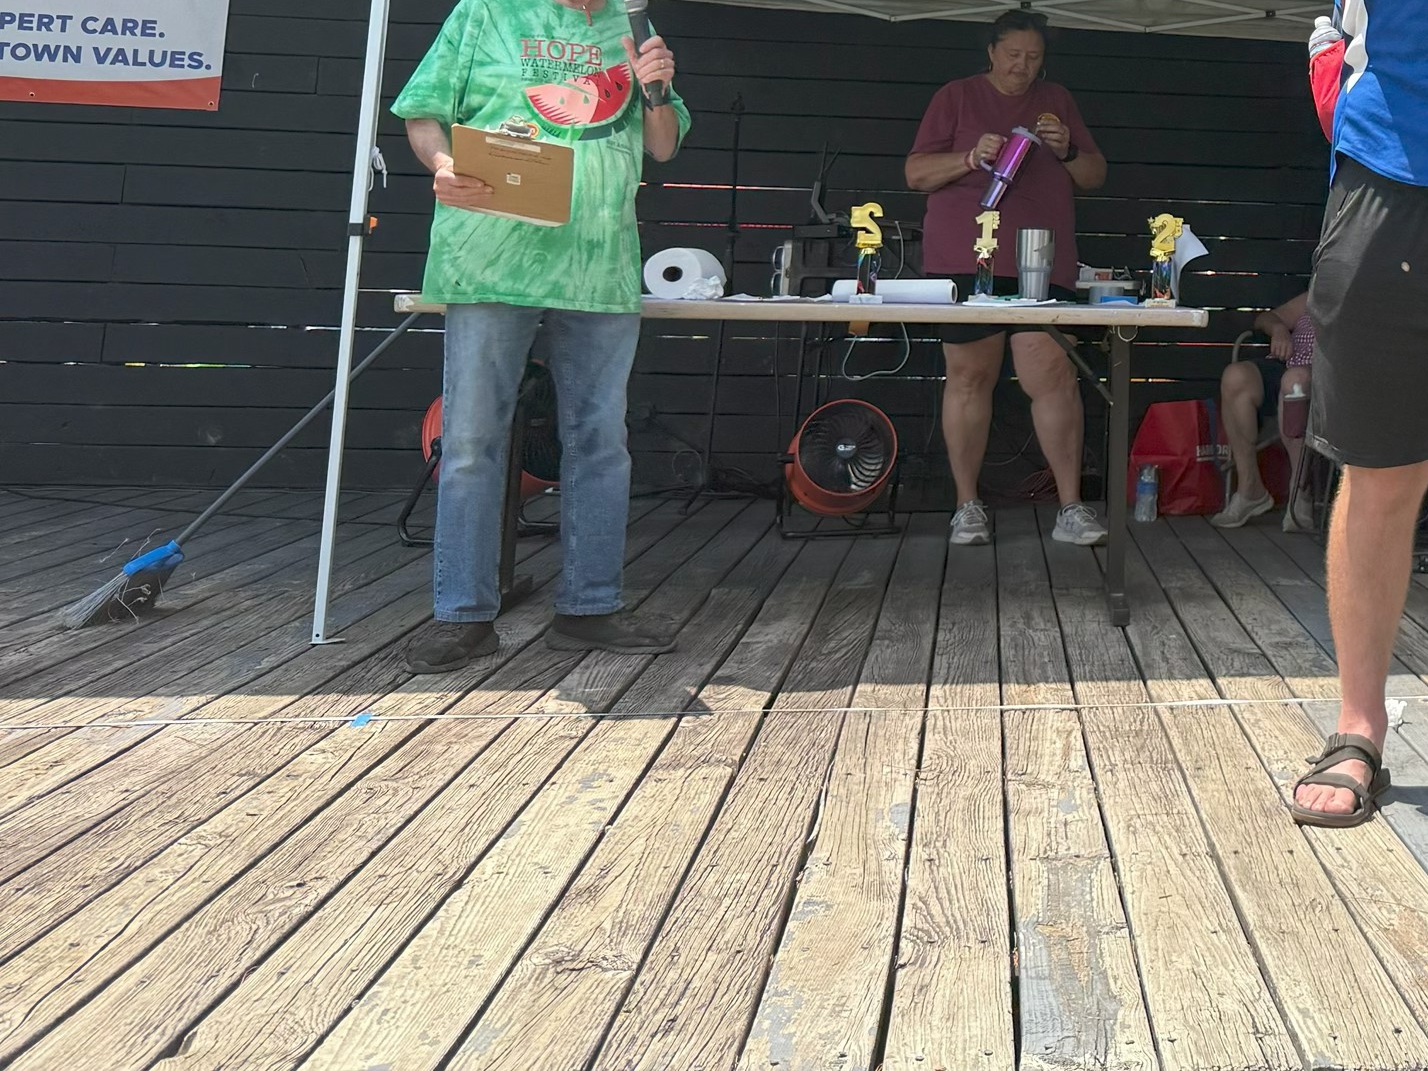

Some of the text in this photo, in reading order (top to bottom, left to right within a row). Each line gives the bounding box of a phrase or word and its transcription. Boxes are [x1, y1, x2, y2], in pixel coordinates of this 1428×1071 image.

[0, 12, 165, 38] PERT CARE.
[93, 47, 212, 71] VALUES.
[520, 38, 602, 66] HOPE
